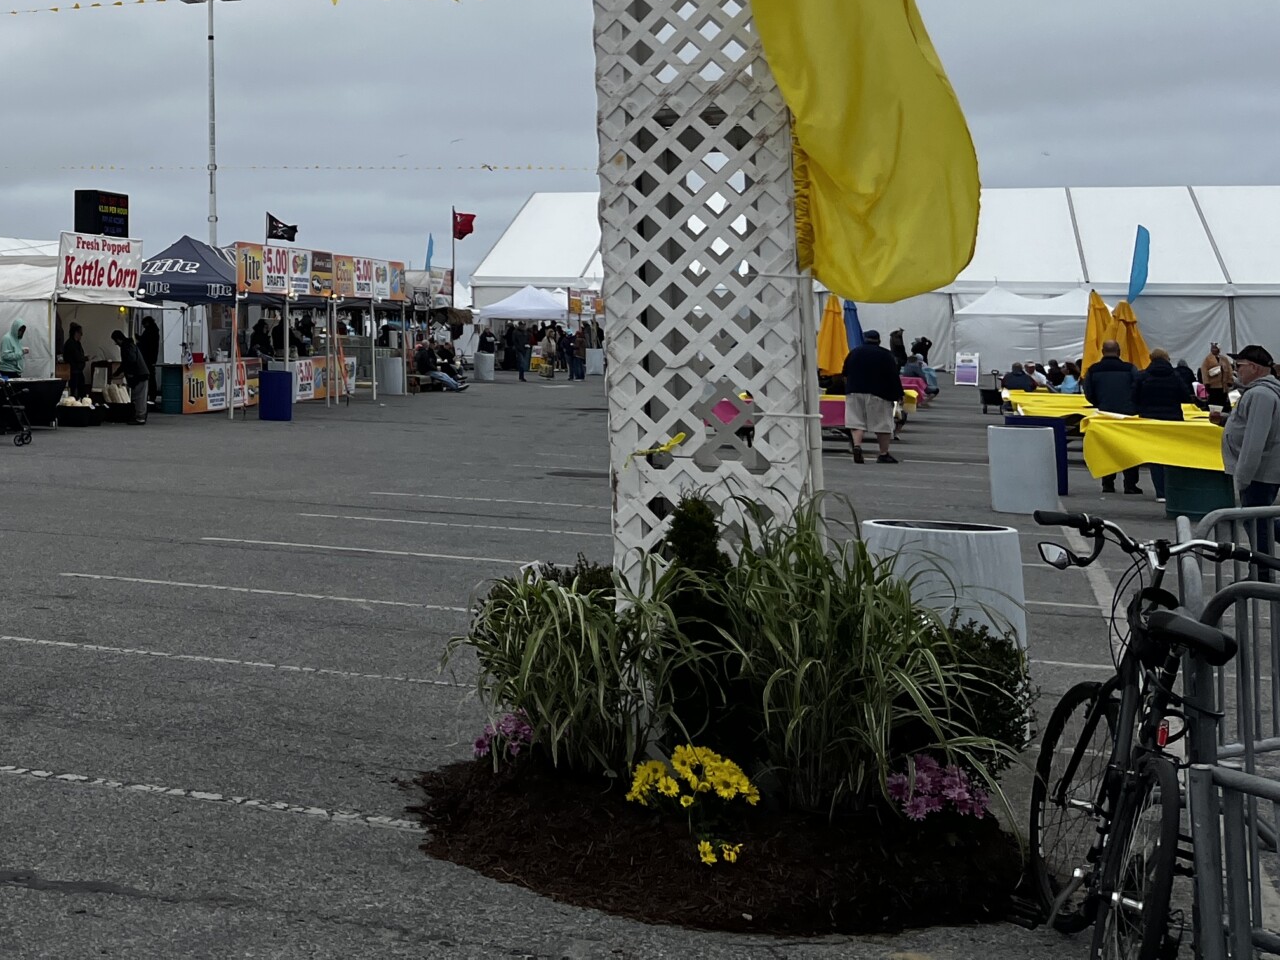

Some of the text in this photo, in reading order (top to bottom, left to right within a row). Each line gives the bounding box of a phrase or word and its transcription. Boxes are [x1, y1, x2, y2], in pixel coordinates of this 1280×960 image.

[76, 236, 131, 256] Fresh Popped
[140, 258, 200, 276] Lite
[242, 253, 261, 287] Lite
[263, 248, 287, 275] $5.00
[63, 255, 138, 289] Kettle Corn
[266, 275, 285, 287] DRAFTS
[145, 281, 170, 296] Lite
[206, 283, 233, 299] Lite
[187, 377, 204, 405] Lite
